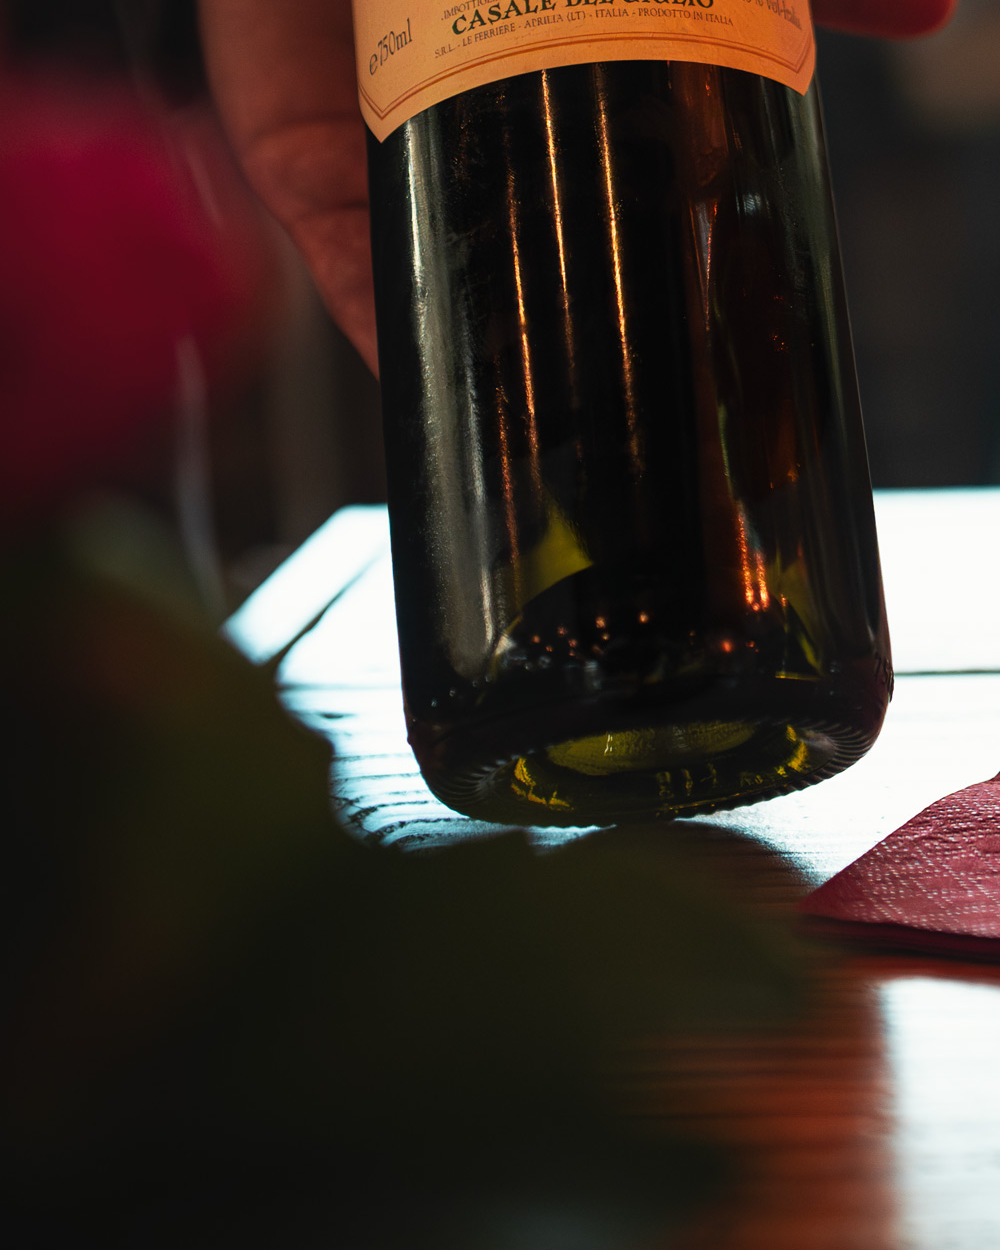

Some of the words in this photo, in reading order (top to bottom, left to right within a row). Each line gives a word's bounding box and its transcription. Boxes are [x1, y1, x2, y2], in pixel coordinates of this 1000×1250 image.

[462, 36, 473, 47] LE
[474, 22, 516, 43] FERRIERE
[524, 14, 563, 29] APRILIA
[566, 10, 586, 22] (LT)
[595, 7, 629, 18] ITALIA
[638, 7, 691, 19] PRODOTTO
[693, 11, 703, 21] IN
[705, 13, 734, 27] ITALIA
